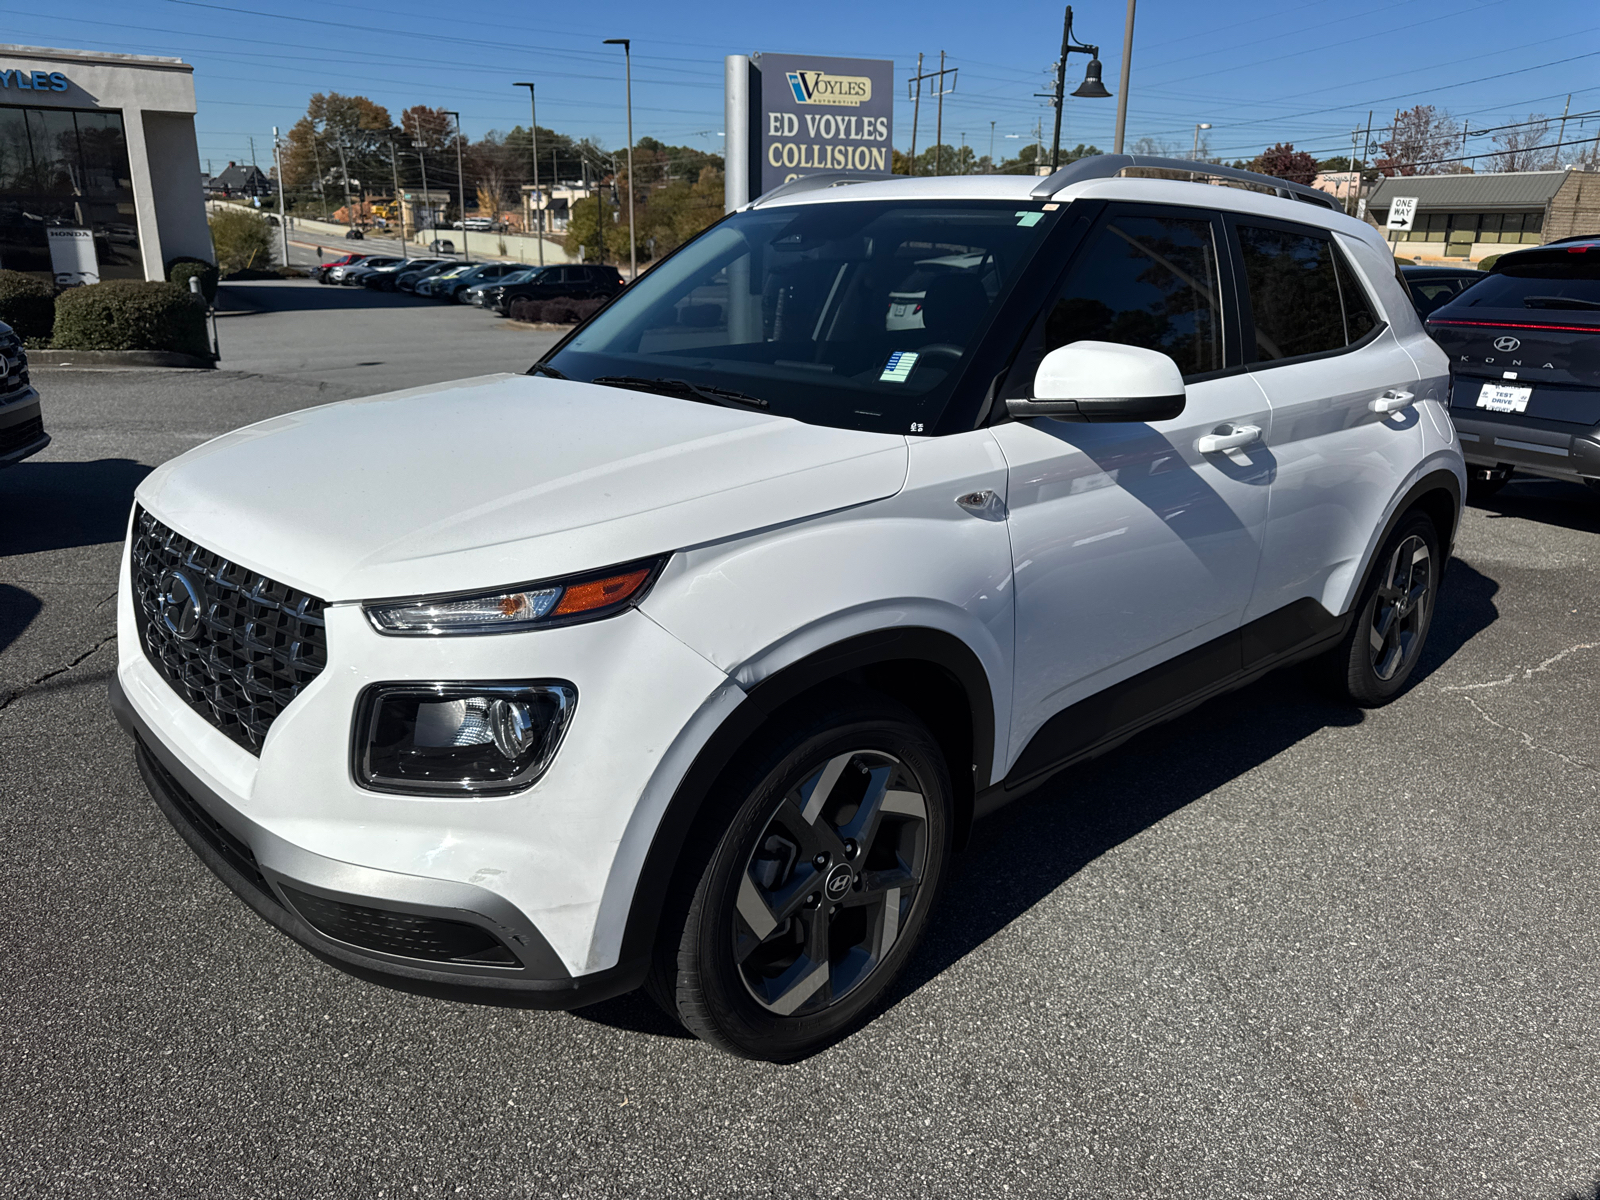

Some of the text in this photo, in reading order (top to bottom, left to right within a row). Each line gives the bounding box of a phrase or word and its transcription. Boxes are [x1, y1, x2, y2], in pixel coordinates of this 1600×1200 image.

[799, 72, 866, 99] VOYLES
[768, 112, 888, 141] ED VOYLES
[768, 142, 887, 171] COLLISION
[1394, 208, 1411, 216] WAY
[1395, 199, 1413, 207] ONE
[1460, 355, 1554, 369] KONA
